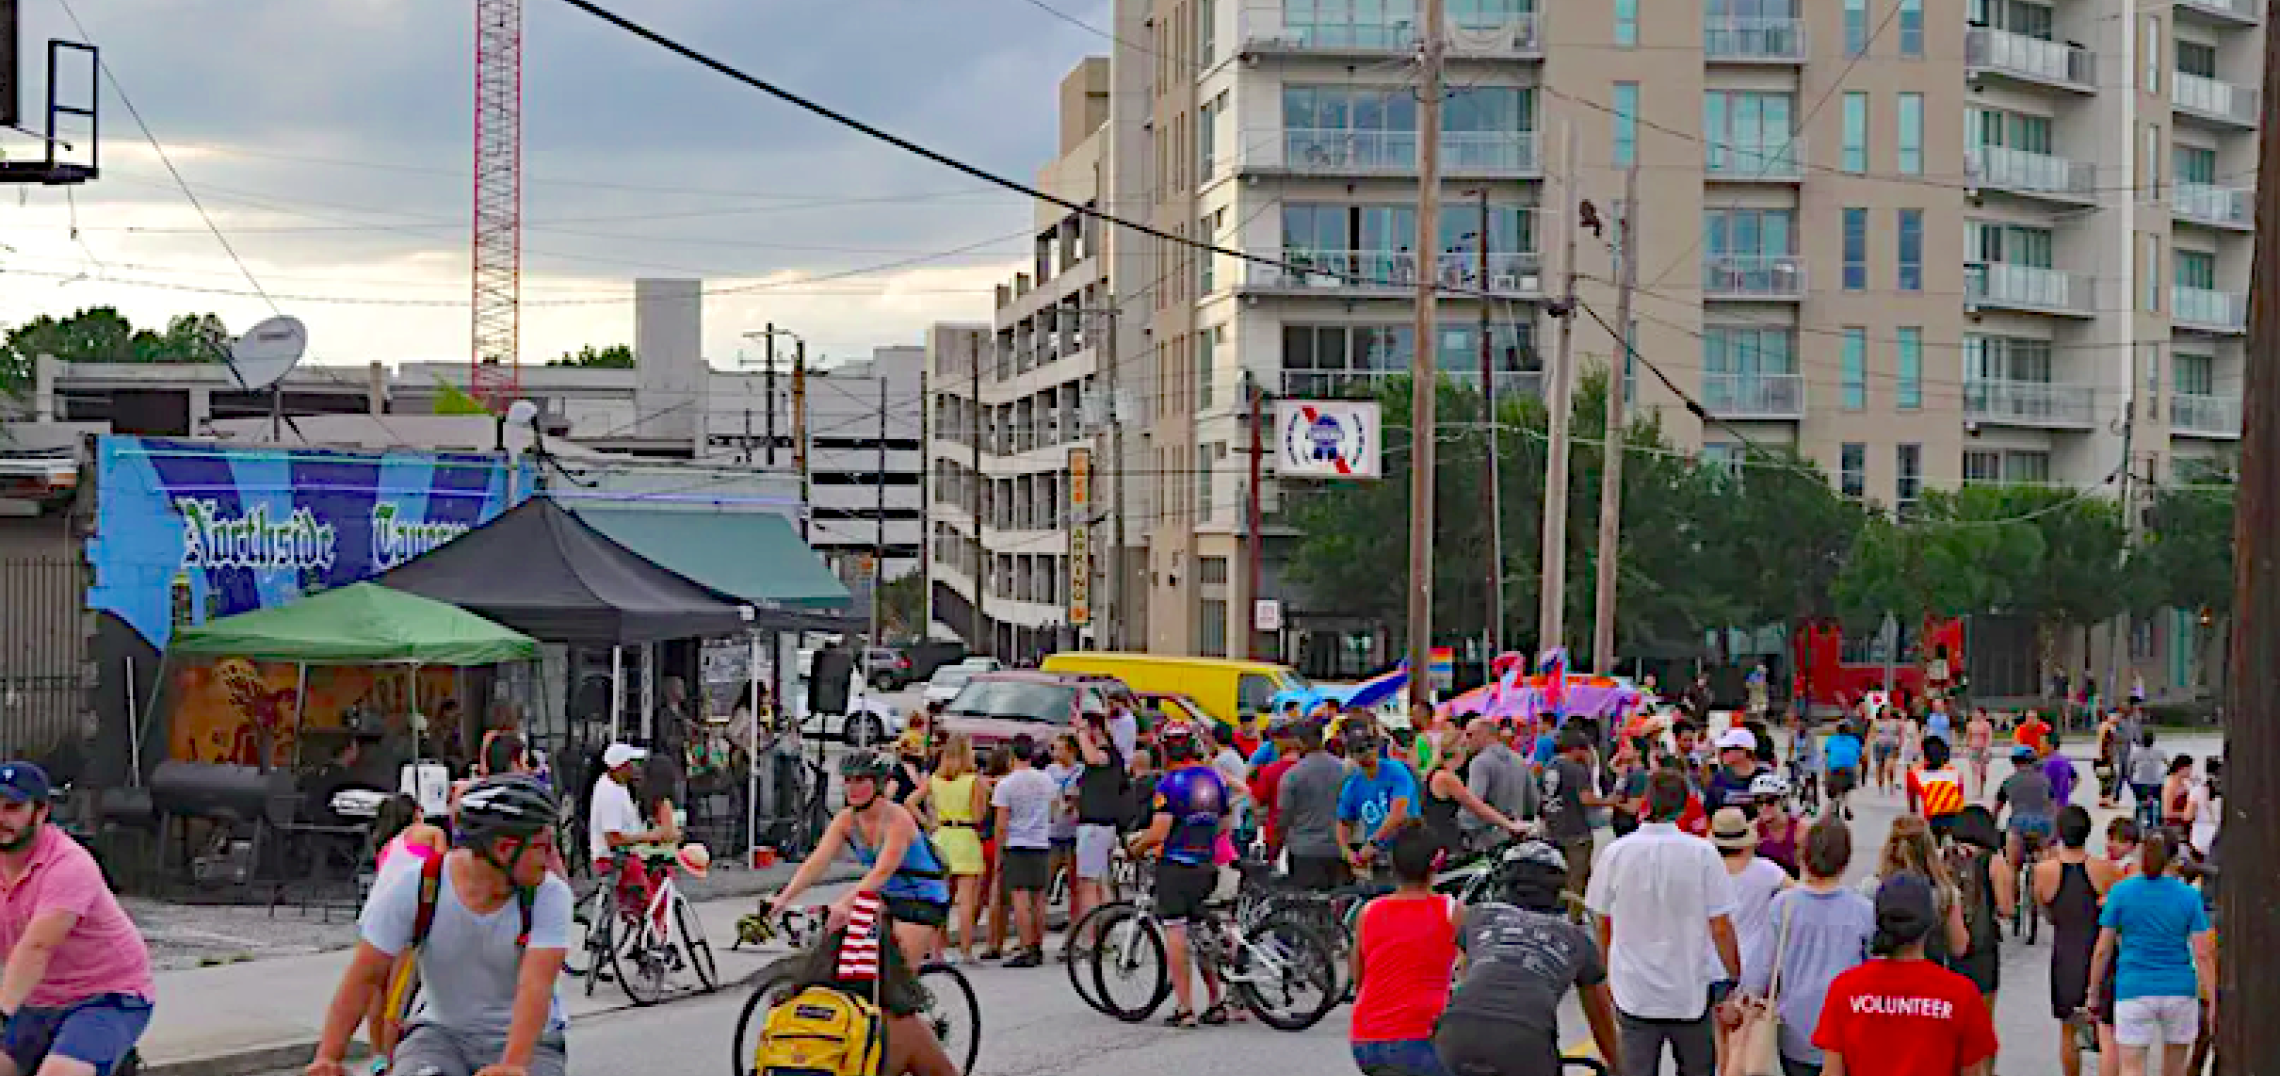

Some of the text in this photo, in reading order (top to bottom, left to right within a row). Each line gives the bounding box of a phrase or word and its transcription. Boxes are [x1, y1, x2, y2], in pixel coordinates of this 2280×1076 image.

[173, 497, 335, 572] Northside
[1072, 511, 1086, 601] ARKING
[1848, 993, 1953, 1020] VOLUNTEER
